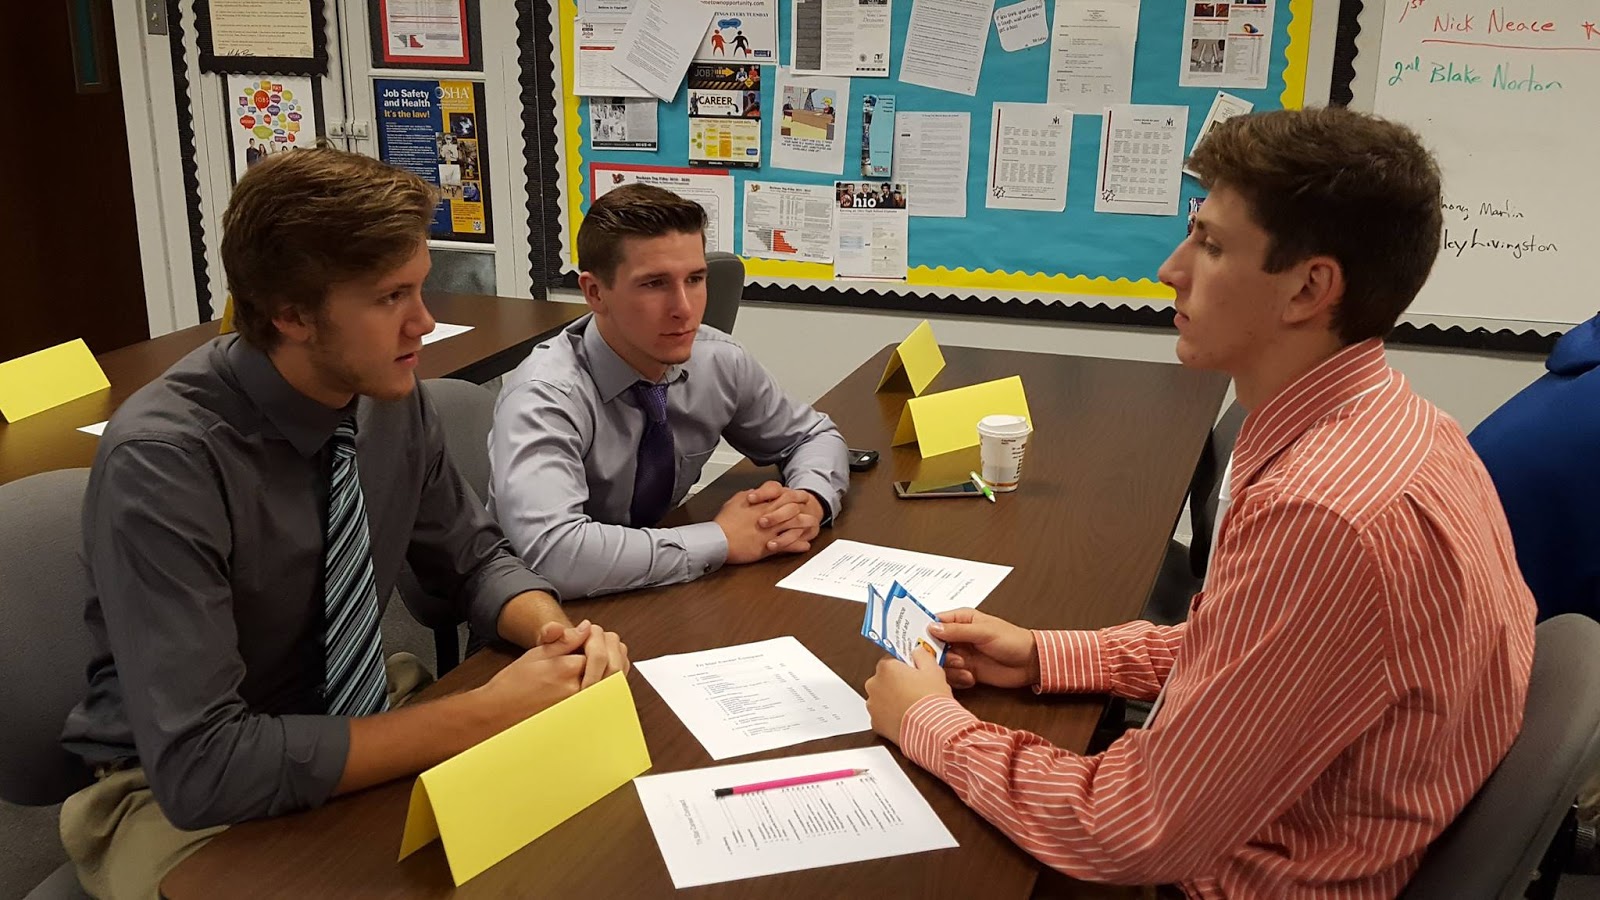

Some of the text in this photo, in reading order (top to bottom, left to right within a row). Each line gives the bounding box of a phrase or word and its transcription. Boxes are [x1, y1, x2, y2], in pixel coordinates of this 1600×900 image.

[1433, 6, 1556, 34] Nick Neace
[1388, 56, 1562, 92] 2nd Blake Norton
[383, 89, 429, 99] Job Safety
[434, 86, 469, 99] OSHA
[402, 99, 430, 108] Health
[699, 96, 732, 105] CAREER
[412, 110, 430, 118] law!
[1440, 196, 1469, 220] hony
[1444, 228, 1558, 259] ley Livingston
